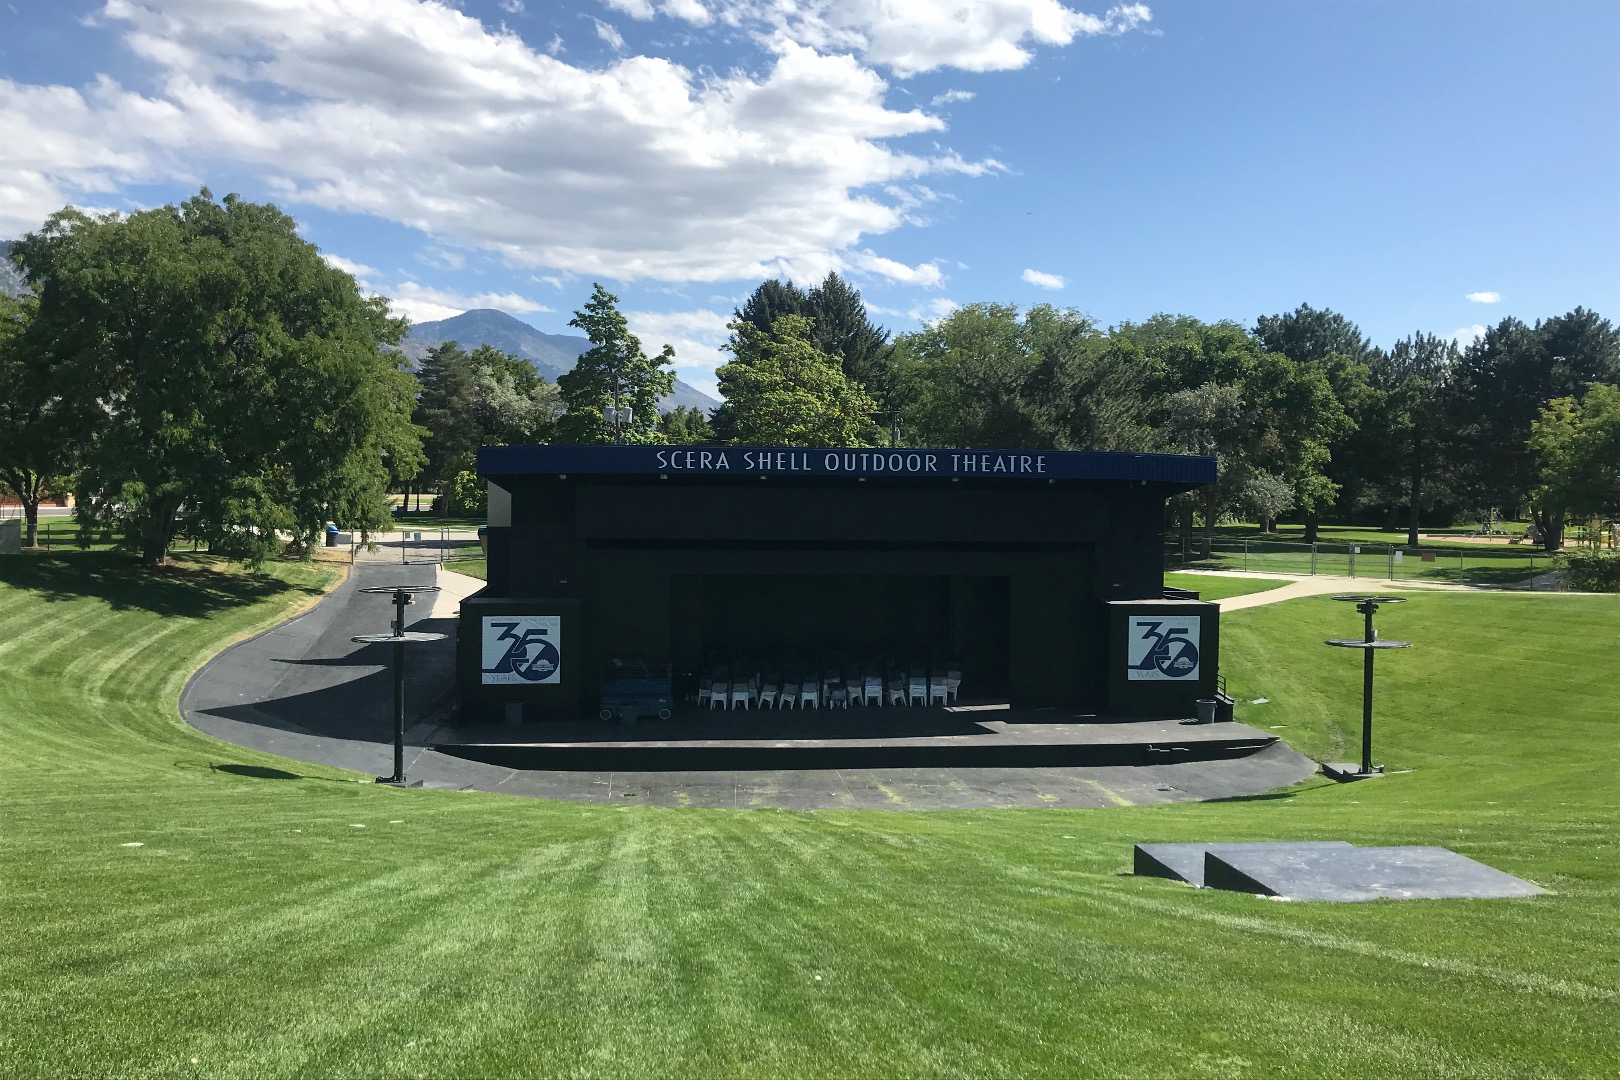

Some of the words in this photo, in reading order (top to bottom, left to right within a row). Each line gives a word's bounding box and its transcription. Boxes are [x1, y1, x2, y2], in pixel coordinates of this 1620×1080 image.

[656, 450, 730, 470] SCERA
[744, 451, 812, 471] SHELL
[824, 453, 938, 472] OUTDOOR
[951, 454, 1047, 473] THEATRE
[491, 674, 517, 682] YEARS
